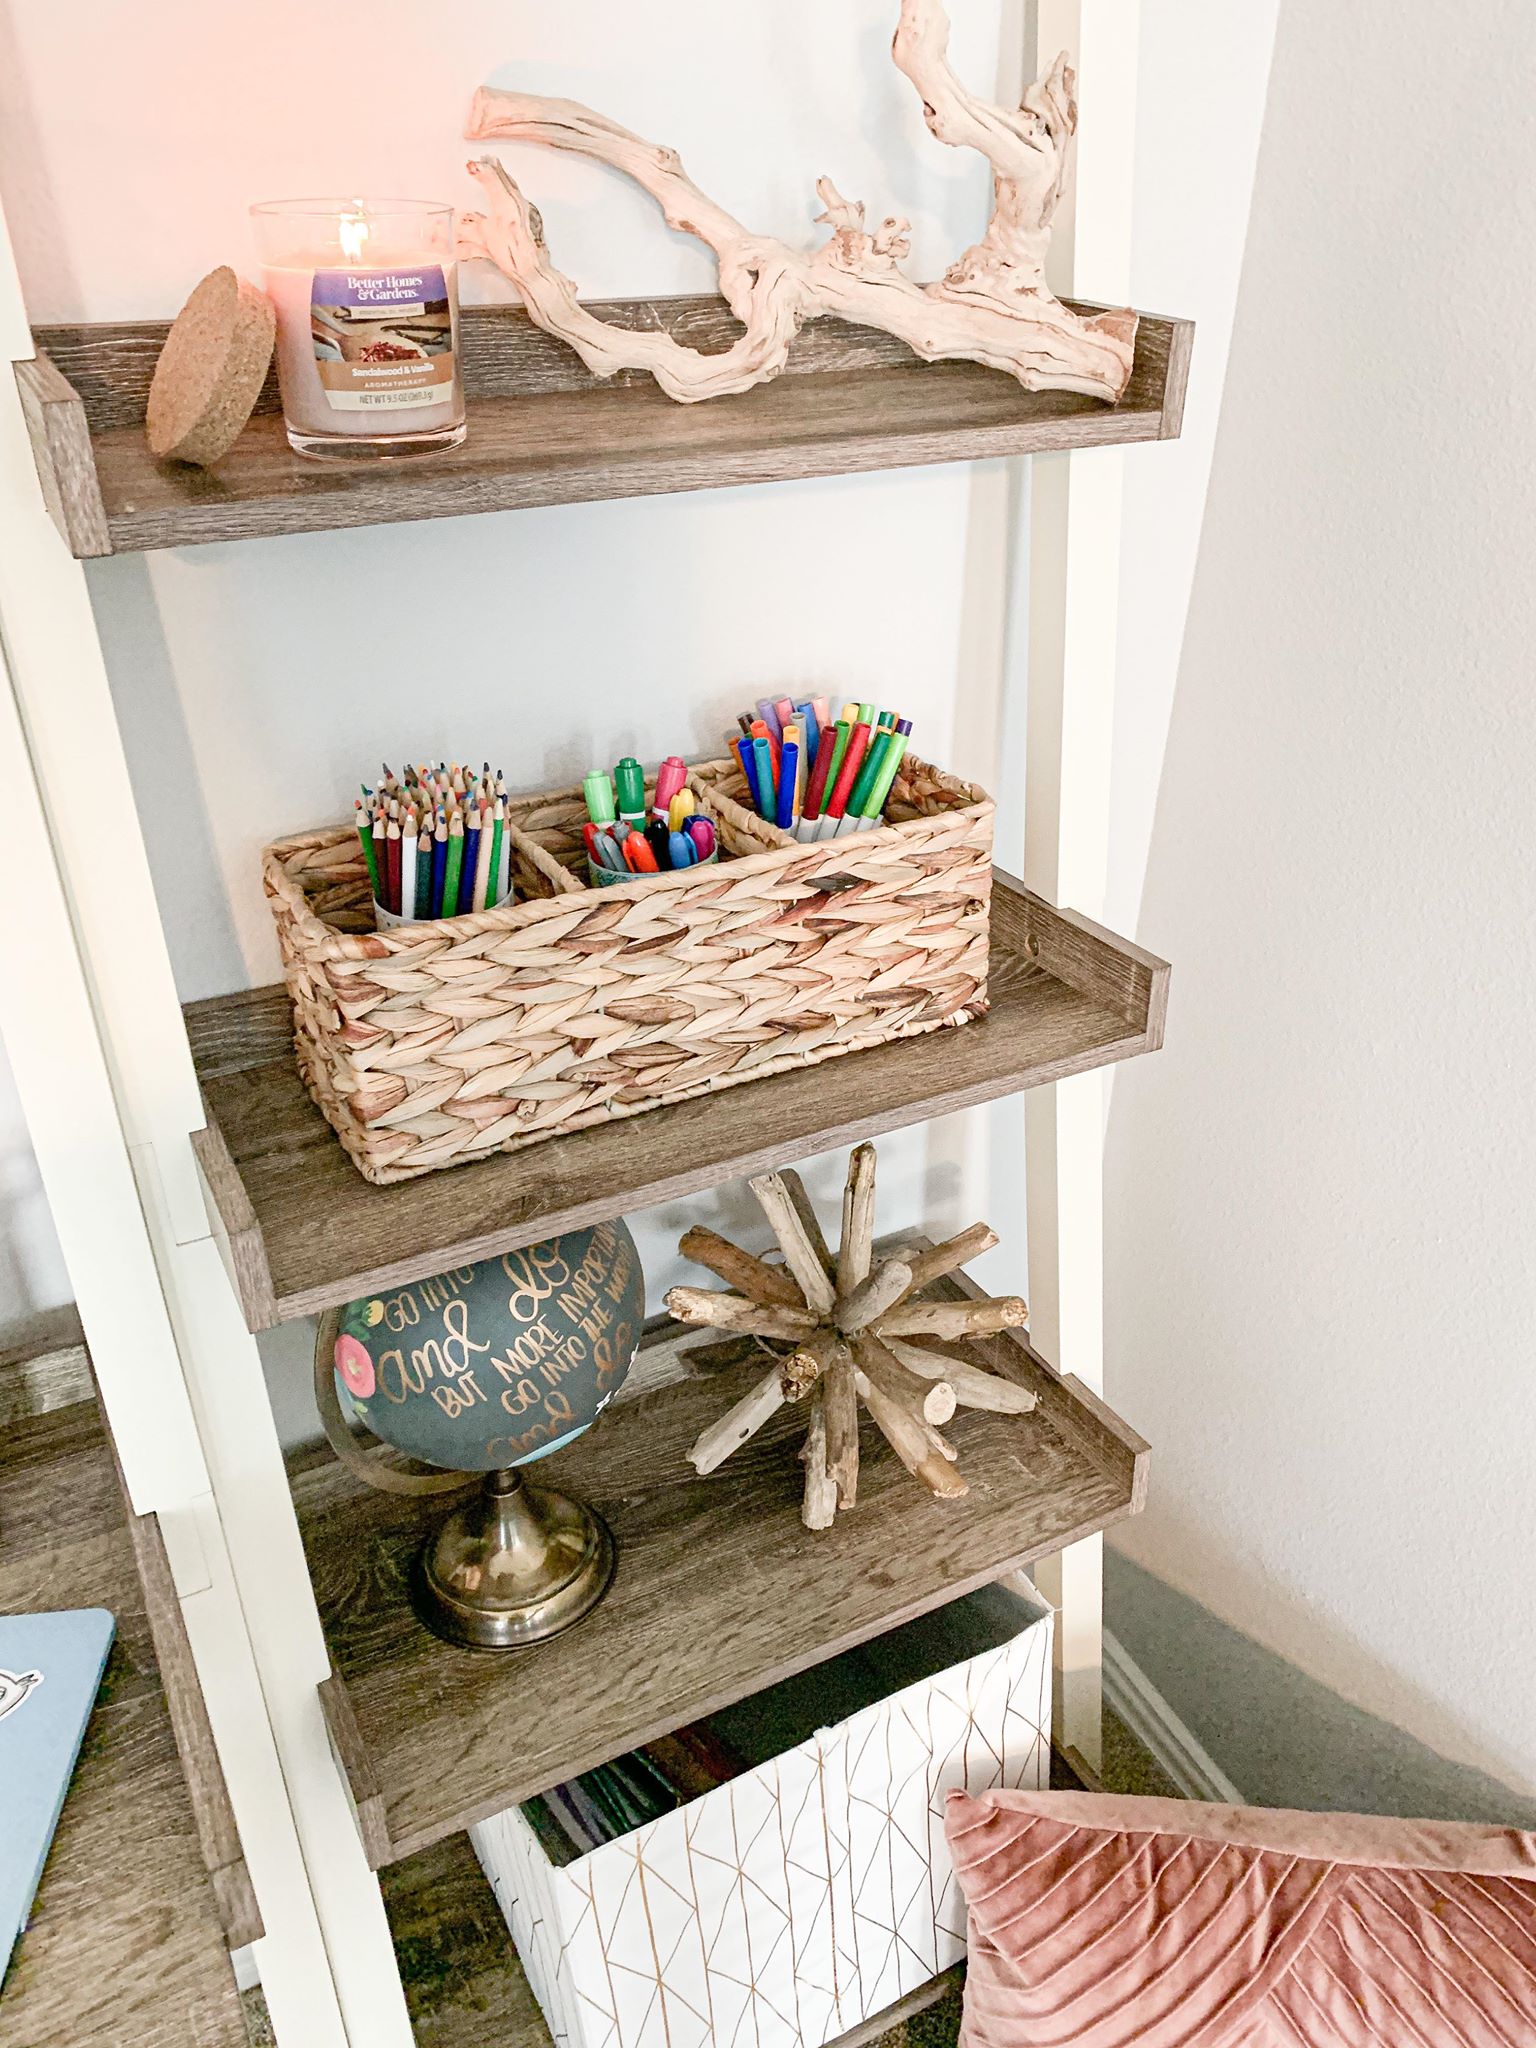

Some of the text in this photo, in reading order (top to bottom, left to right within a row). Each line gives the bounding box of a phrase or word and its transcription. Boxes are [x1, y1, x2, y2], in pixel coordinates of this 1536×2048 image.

[347, 276, 423, 289] Better Homes
[360, 395, 373, 404] NET
[385, 1291, 420, 1332] GO
[378, 1299, 490, 1404] and
[430, 1370, 488, 1418] BUT
[490, 1313, 565, 1384] MORE
[500, 1378, 541, 1416] GO
[539, 1335, 588, 1386] INTO
[577, 1298, 614, 1343] THE
